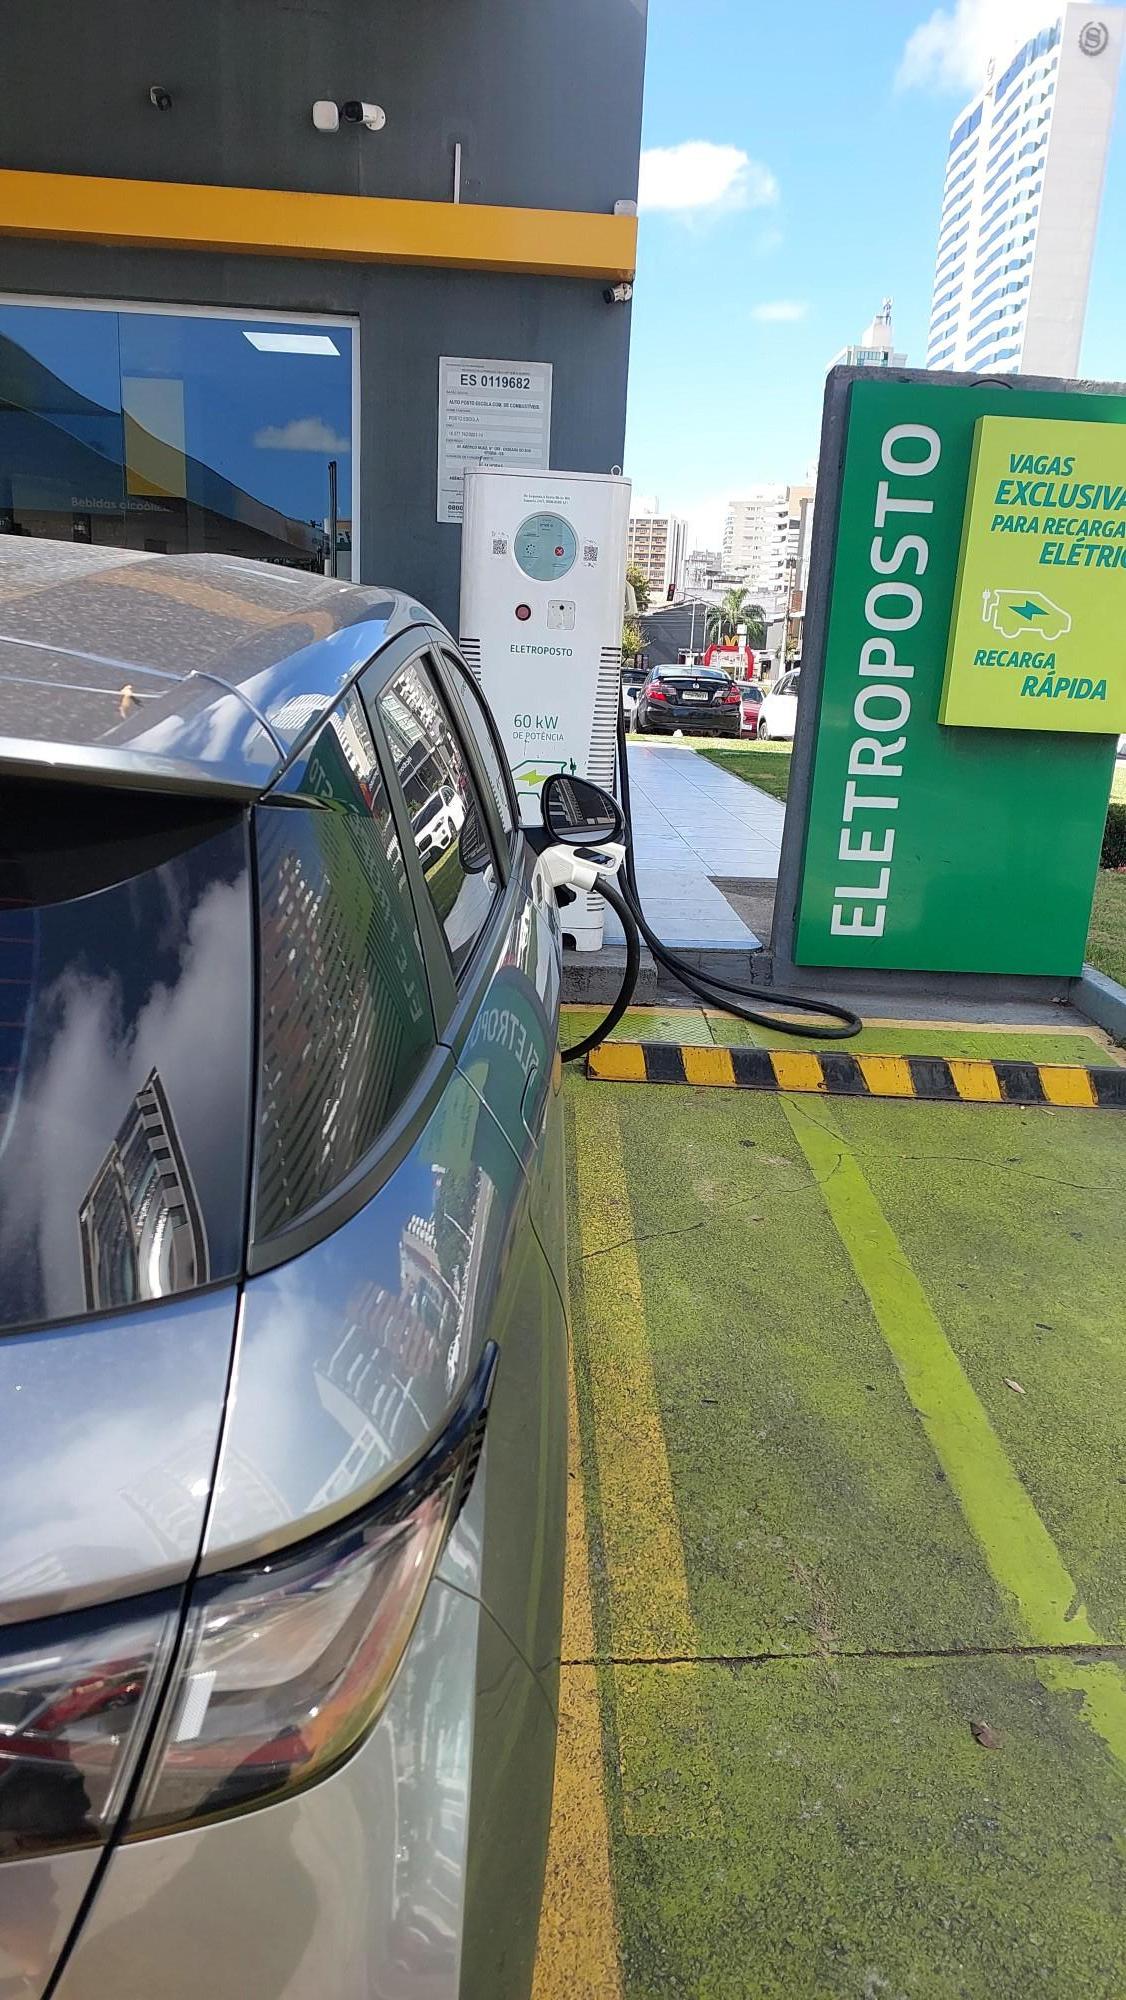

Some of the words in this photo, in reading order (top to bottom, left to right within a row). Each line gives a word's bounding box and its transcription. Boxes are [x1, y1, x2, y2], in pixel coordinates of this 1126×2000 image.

[460, 373, 477, 387] ES
[481, 376, 530, 390] 0119682
[1009, 453, 1076, 476] VAGAS
[71, 496, 117, 509] Bebidas
[991, 514, 1039, 534] PARA
[1042, 517, 1126, 538] RECARGA
[510, 644, 573, 657] ELETROPOSTO
[974, 649, 1056, 670] RECARGA
[830, 423, 942, 938] ELETROPOSTO
[1020, 671, 1107, 701] RÁPIDA
[514, 714, 532, 728] 60
[536, 715, 558, 729] kW
[512, 731, 523, 740] DE
[525, 730, 564, 742] POTÊNCIA
